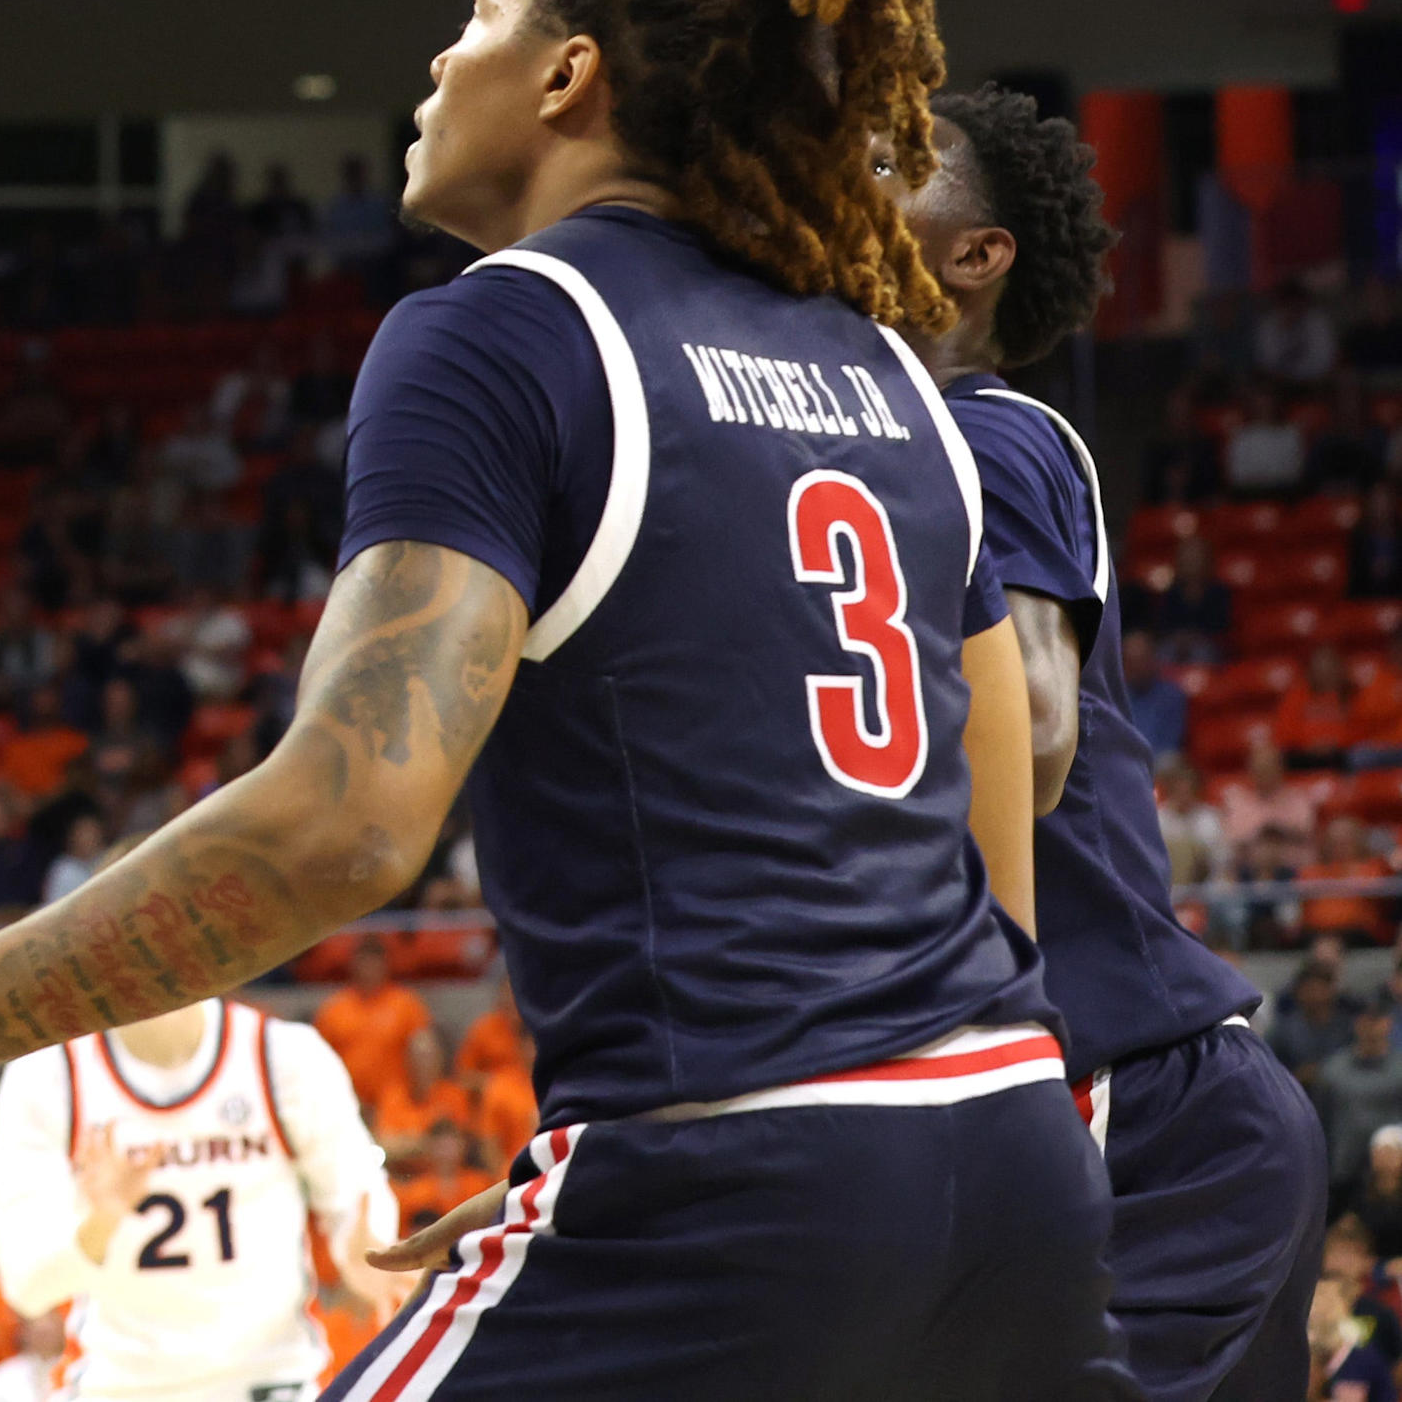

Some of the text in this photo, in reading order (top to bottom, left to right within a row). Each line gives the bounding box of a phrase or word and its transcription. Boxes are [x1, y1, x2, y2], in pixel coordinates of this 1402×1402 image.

[682, 343, 860, 436] MITCHELL
[787, 468, 929, 799] 3
[135, 1185, 236, 1271] 21
